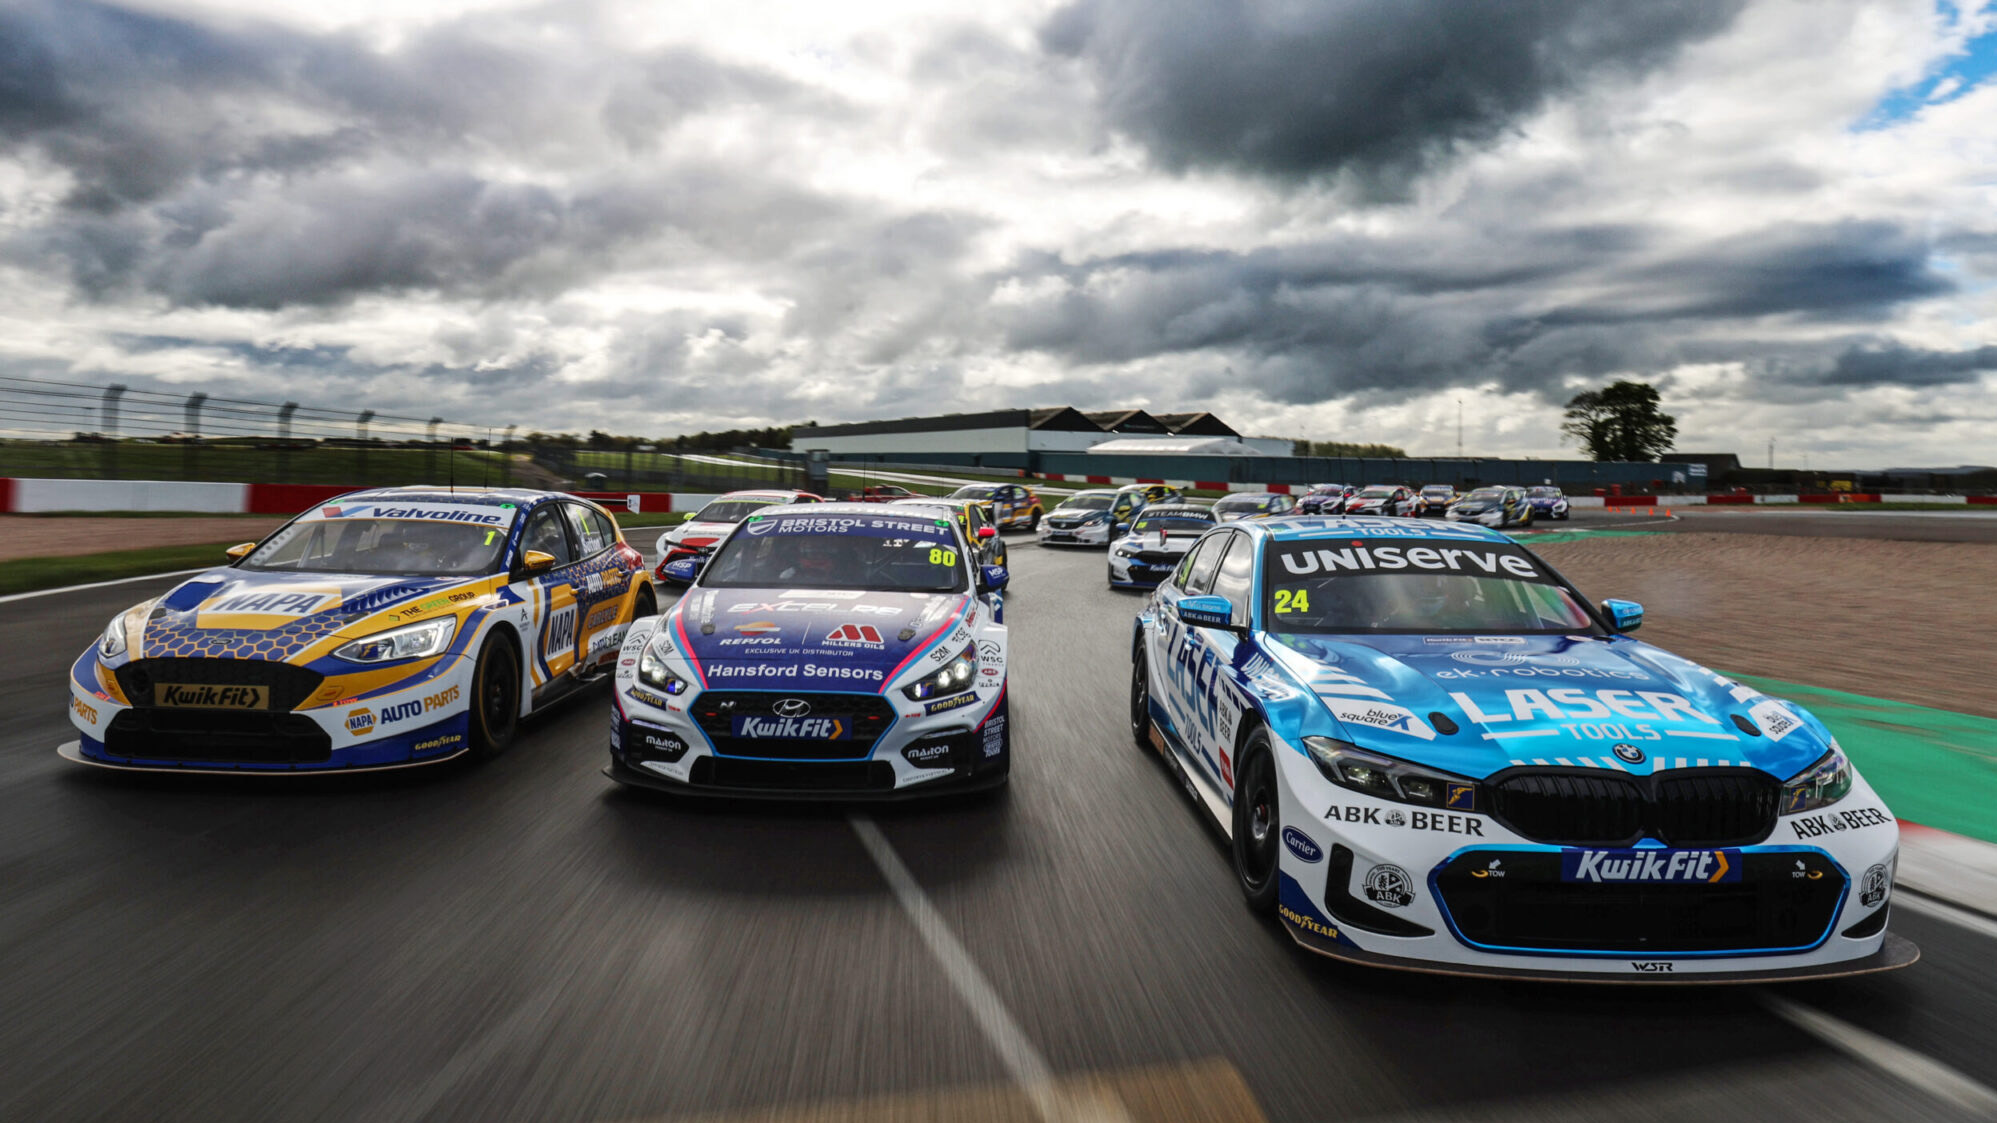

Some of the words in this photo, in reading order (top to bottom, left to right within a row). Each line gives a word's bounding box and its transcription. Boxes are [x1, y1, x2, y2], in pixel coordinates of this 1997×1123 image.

[373, 507, 502, 525] Valvoline
[778, 525, 849, 534] MOTORS
[780, 518, 866, 528] BRISTOL
[871, 520, 949, 536] STREET
[1355, 527, 1428, 536] TOOLS
[484, 531, 496, 546] 1
[928, 548, 956, 567] 80
[212, 593, 328, 614] NAPA
[1274, 589, 1310, 614] 24
[401, 606, 423, 617] THE
[547, 608, 575, 656] NAPA
[719, 637, 782, 646] REPSOL
[822, 640, 861, 648] MILLERS
[980, 655, 1003, 663] WSC
[707, 663, 798, 677] Hansford
[803, 663, 883, 681] Sensors
[73, 697, 98, 725] PARTS
[380, 700, 422, 725] AUTO
[423, 684, 460, 713] PARTS
[930, 693, 975, 712] GOODYEAR
[1448, 688, 1723, 725] LASER
[349, 714, 375, 730] NAPA
[1340, 712, 1388, 726] square
[1366, 708, 1398, 721] blue
[1560, 723, 1662, 741] TOOLS
[1324, 805, 1382, 825] ABK
[1411, 811, 1485, 837] BEER
[1790, 815, 1835, 840] ABK
[1840, 807, 1894, 830] BEER
[1285, 831, 1316, 857] Carrier
[1489, 870, 1506, 878] TOW
[1376, 891, 1402, 904] ABK
[1279, 904, 1338, 940] GOODYEAR
[1631, 962, 1673, 972] WSR
